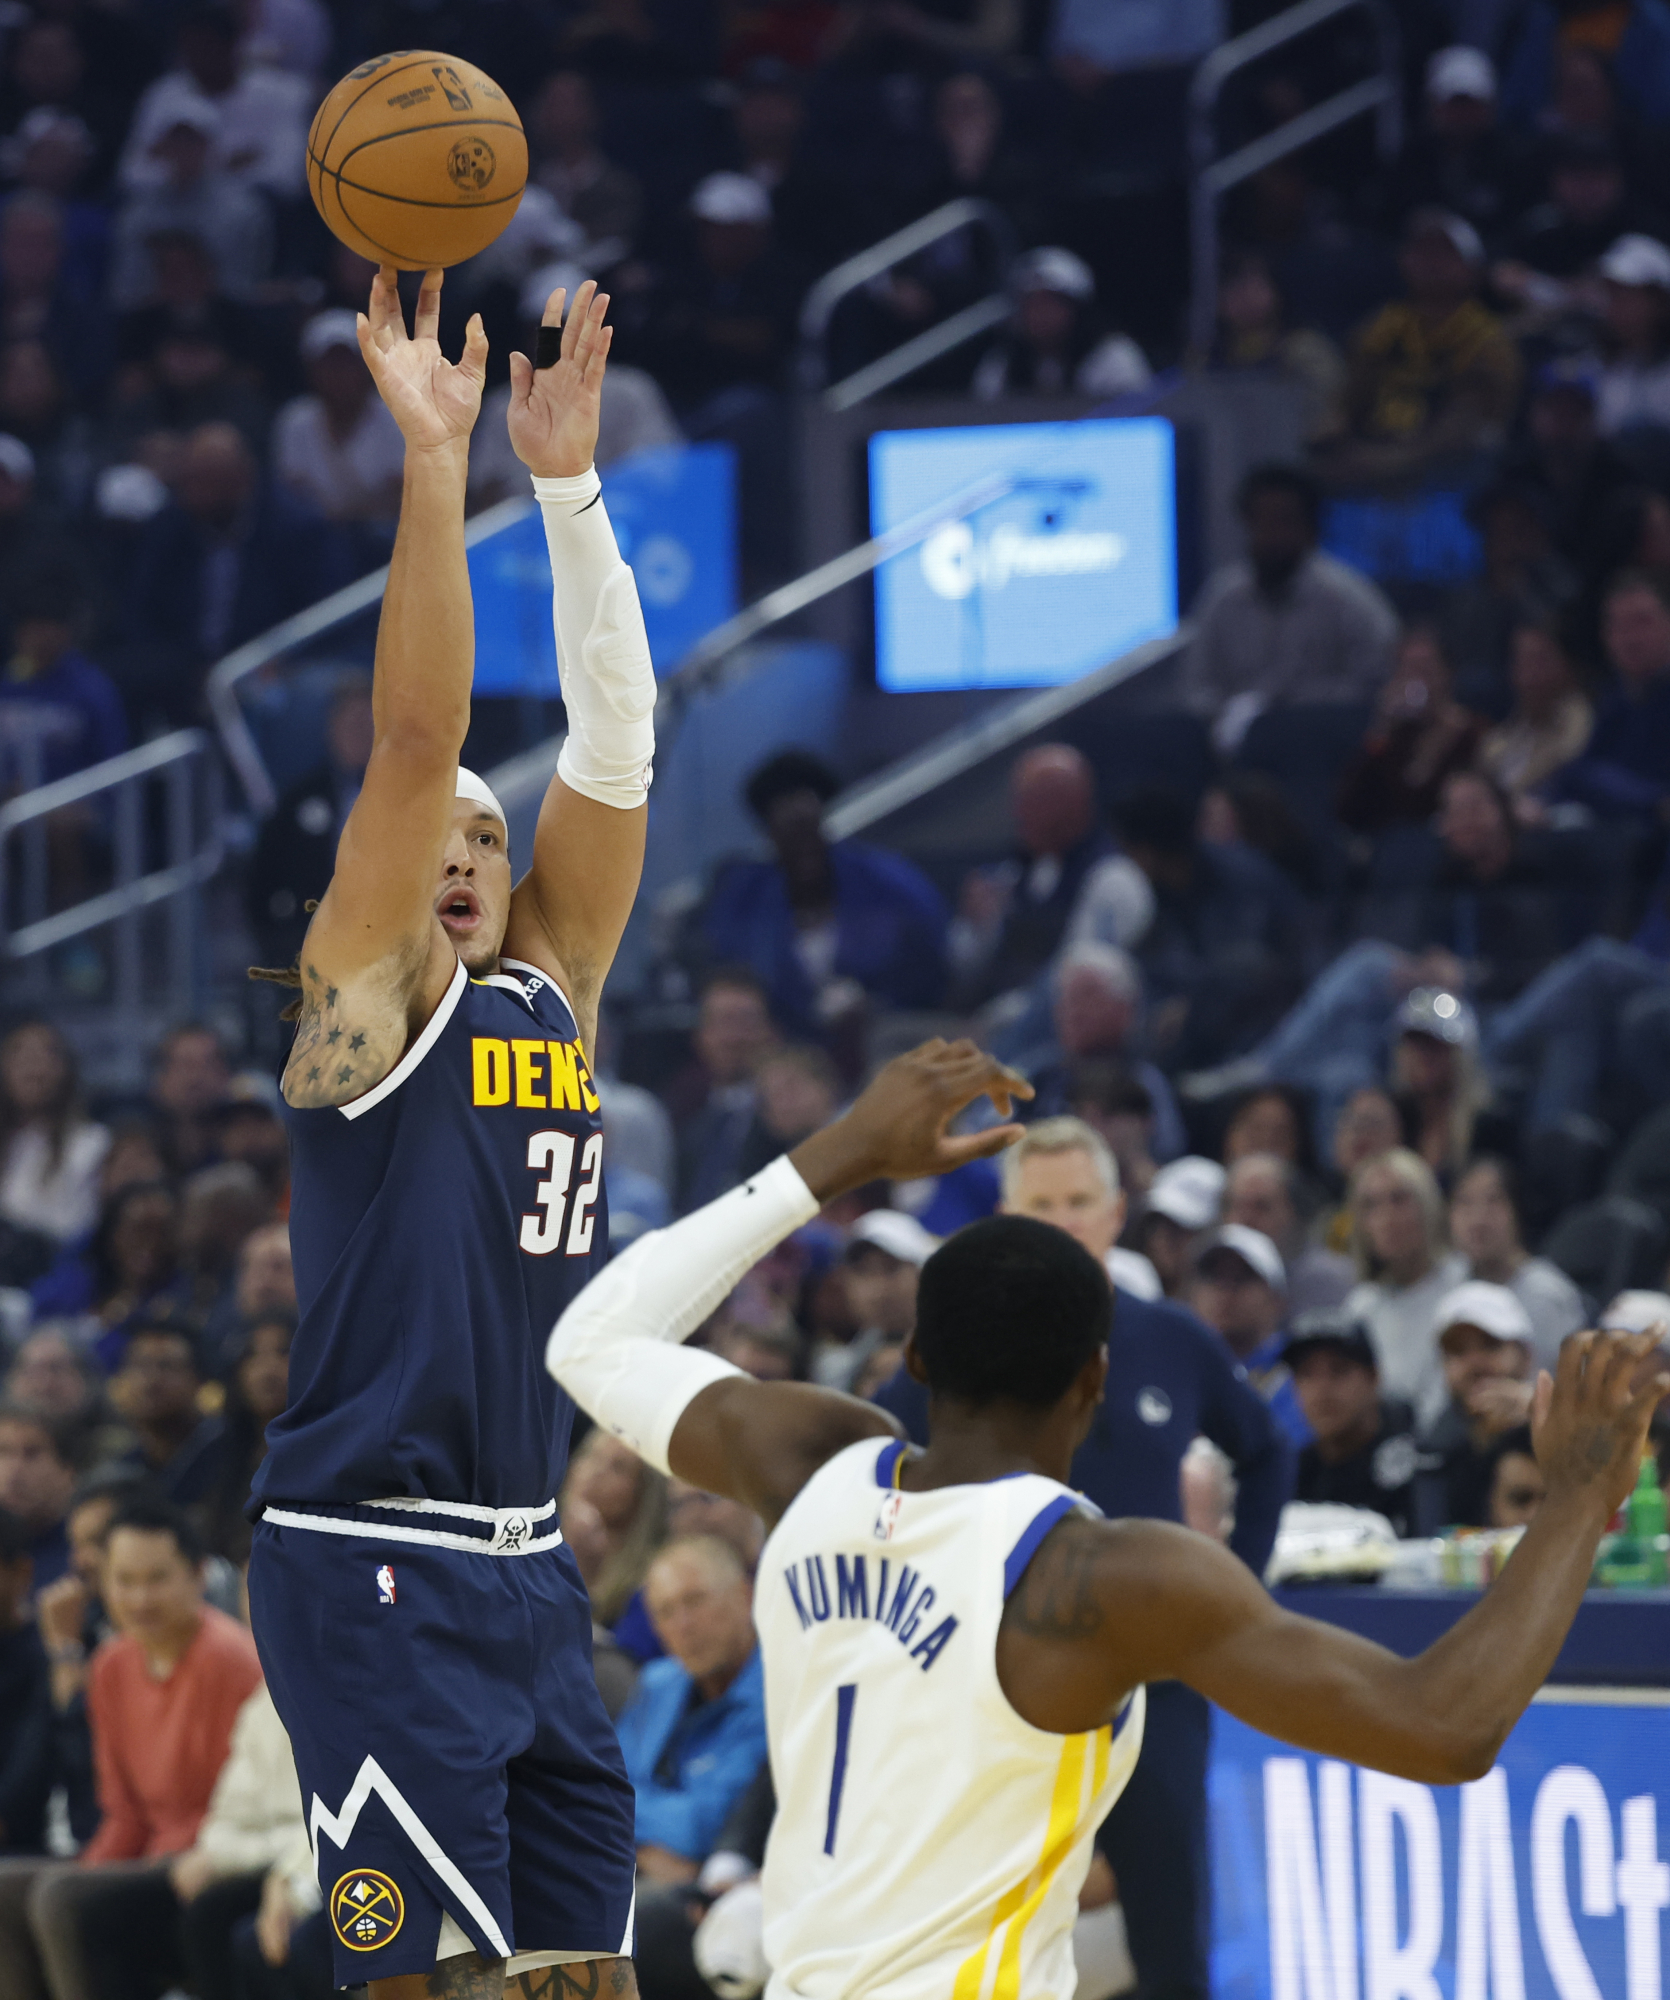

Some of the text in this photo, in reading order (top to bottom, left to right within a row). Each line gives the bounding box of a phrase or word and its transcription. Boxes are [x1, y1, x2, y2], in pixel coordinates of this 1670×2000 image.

[519, 1128, 604, 1257] 32
[784, 1554, 959, 1672] KUMINGA
[823, 1683, 858, 1857] 1
